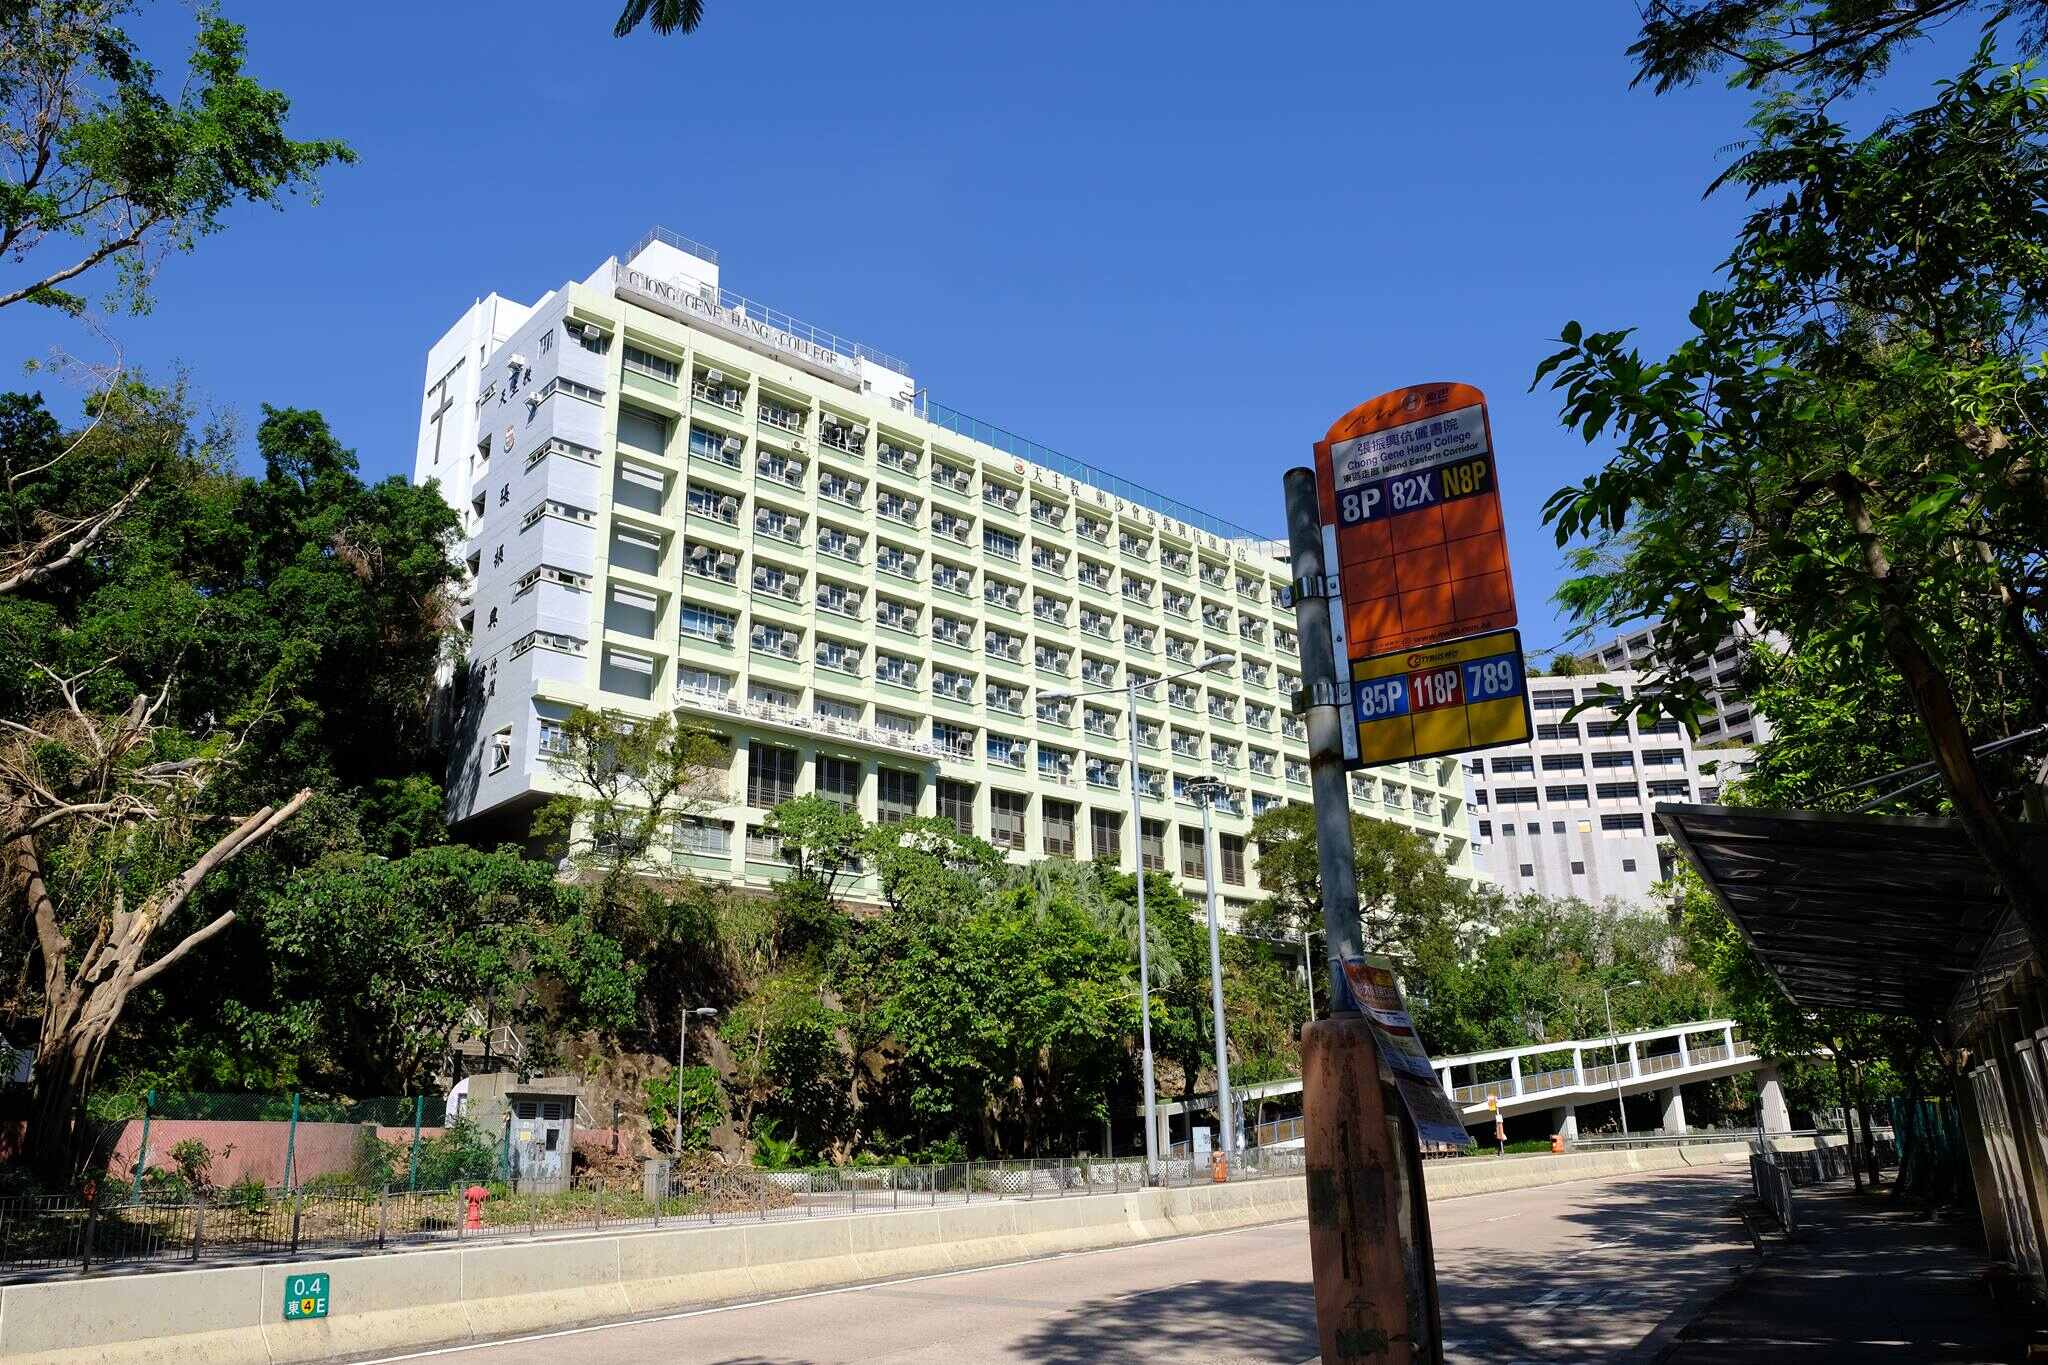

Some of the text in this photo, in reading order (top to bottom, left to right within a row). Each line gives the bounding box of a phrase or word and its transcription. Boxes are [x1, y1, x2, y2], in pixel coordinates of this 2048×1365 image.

[684, 293, 722, 319] GENE
[731, 311, 769, 339] HANG
[779, 332, 838, 364] COLLEGE
[1347, 432, 1472, 471] Chong Gene Hang College
[1382, 459, 1408, 473] Island
[1409, 452, 1441, 466] Eastern
[1443, 442, 1479, 457] Corridor
[1342, 460, 1487, 522] 8P 82X N8P
[1361, 660, 1513, 716] 85P 118P 789
[294, 1277, 322, 1296] 0.4
[287, 1300, 300, 1315] 東
[316, 1298, 326, 1313] E
